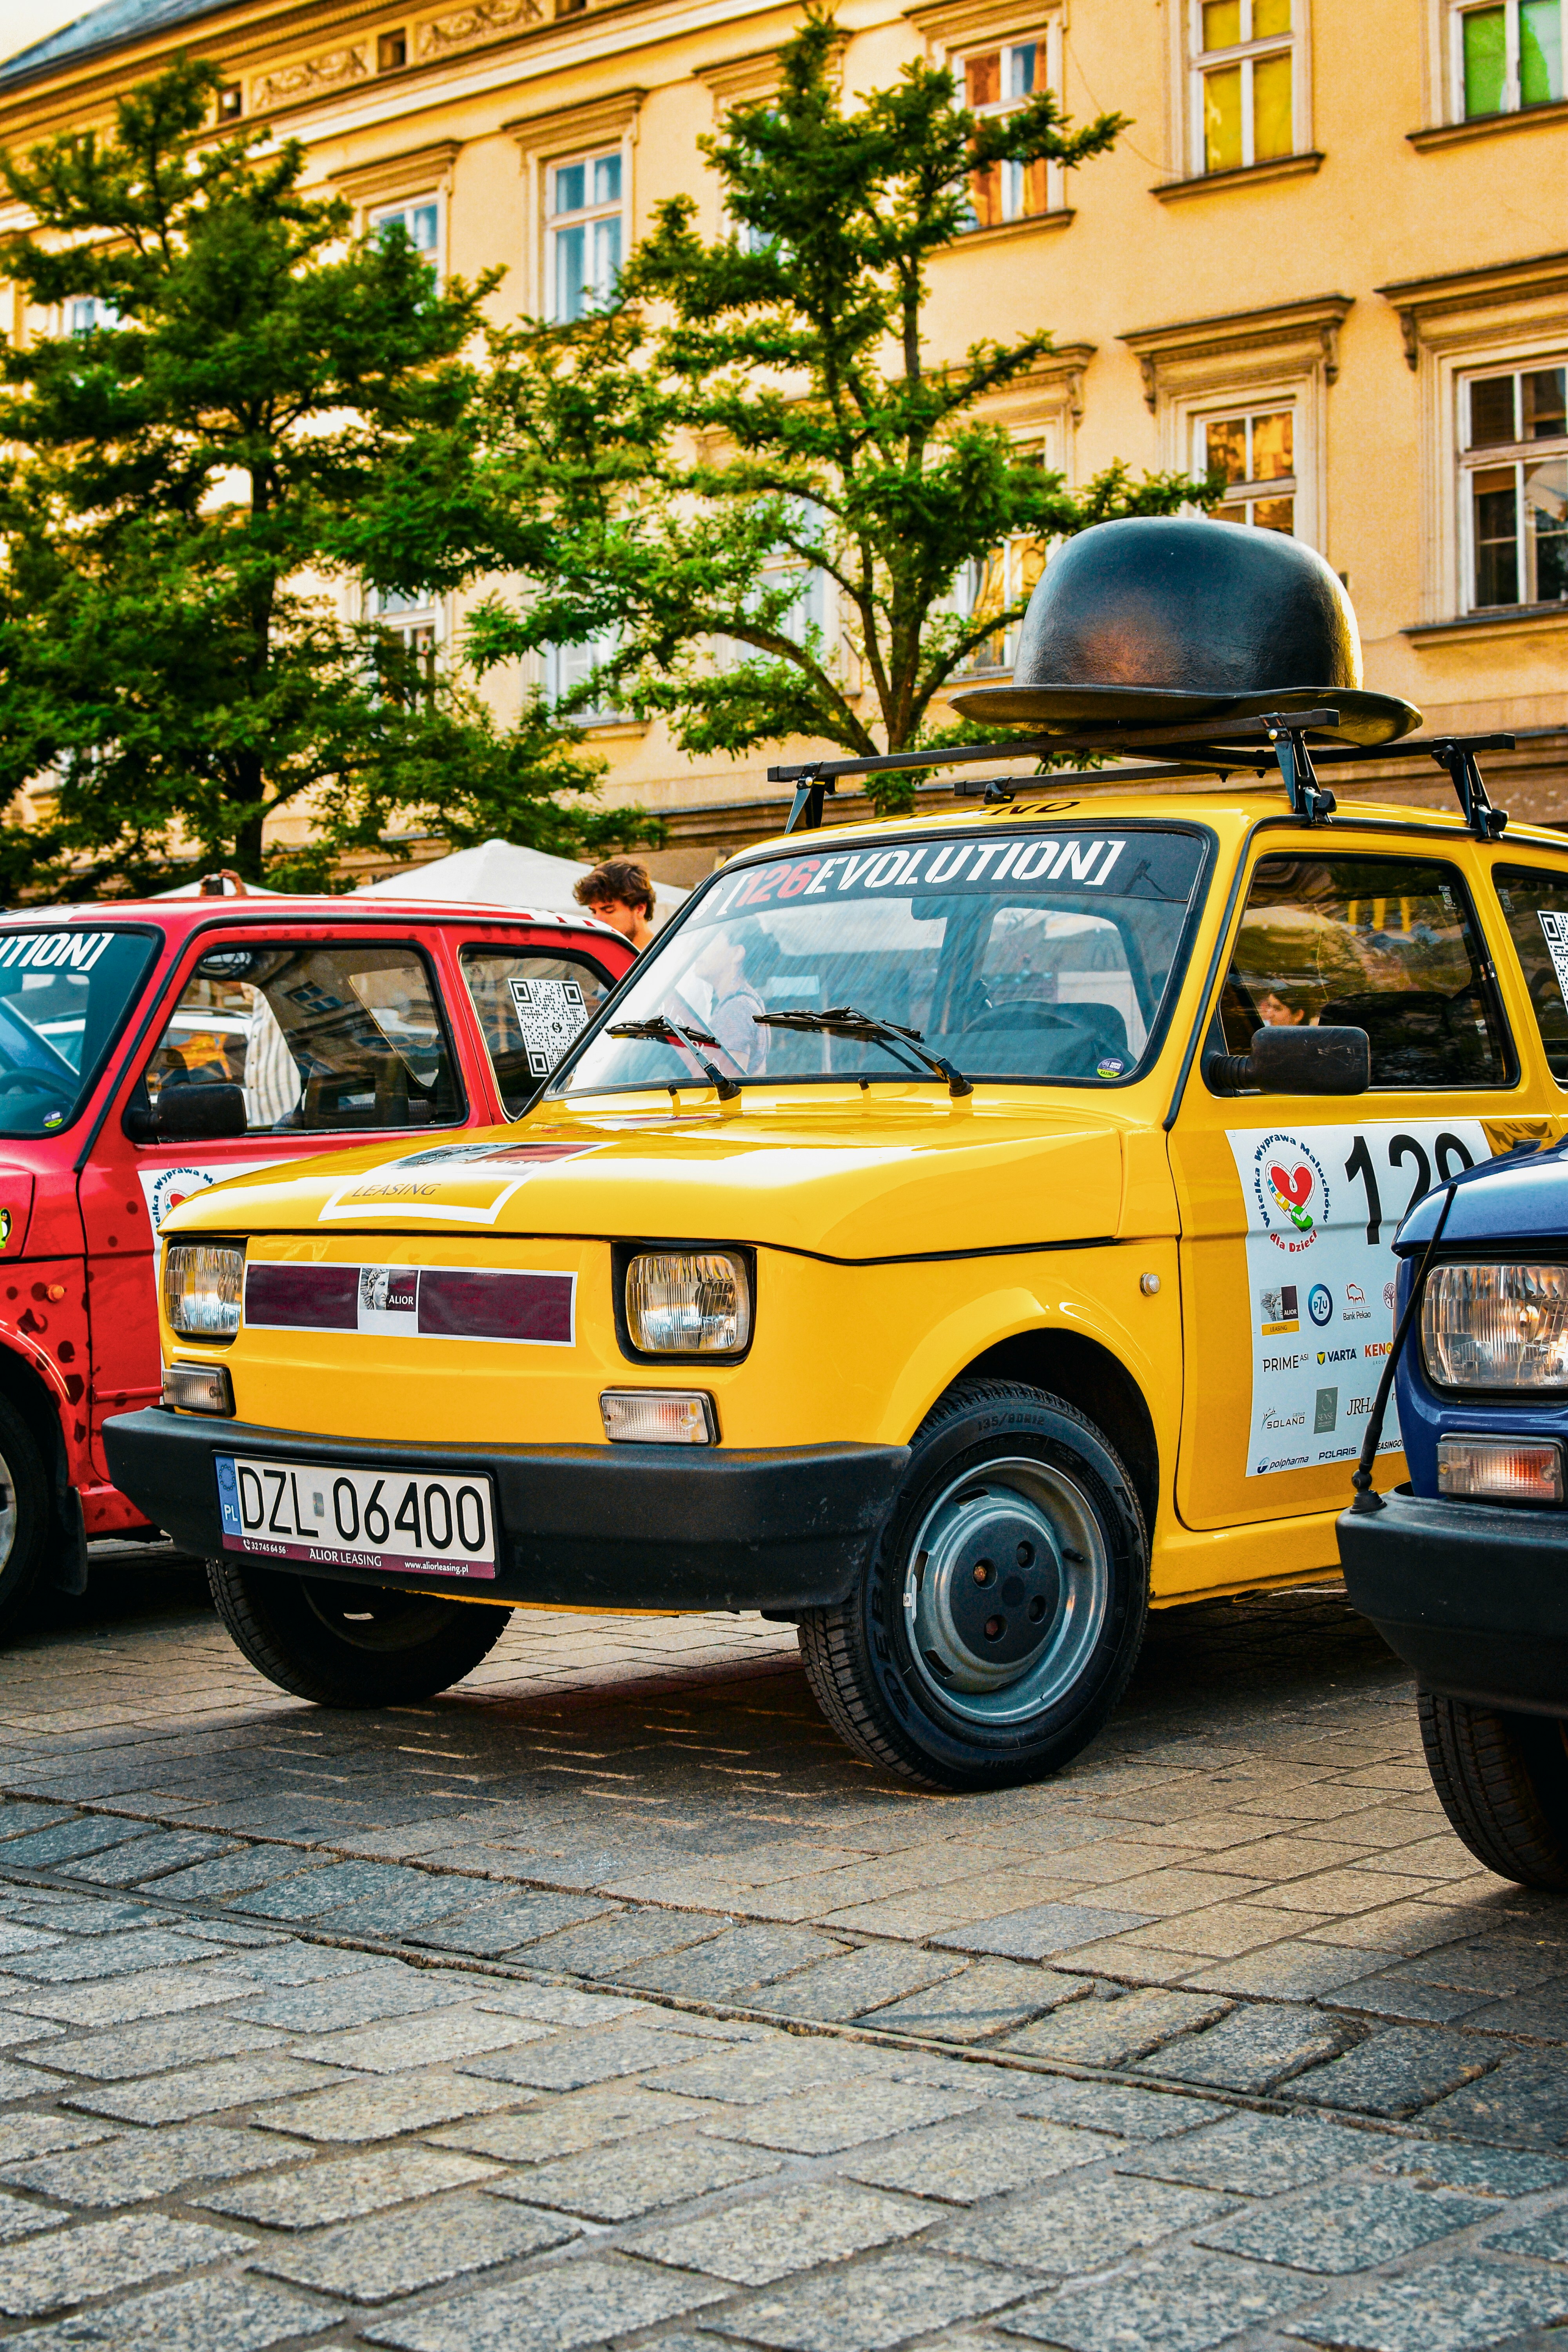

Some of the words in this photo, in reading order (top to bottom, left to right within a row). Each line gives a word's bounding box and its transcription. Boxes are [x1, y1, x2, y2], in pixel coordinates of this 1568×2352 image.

[1254, 1134, 1296, 1161] Wyprawa
[154, 1167, 200, 1191] Wyprawa
[1300, 1142, 1332, 1223] Maluchów
[352, 1183, 441, 1198] LEASING
[1254, 1167, 1270, 1228] Wielka
[1270, 1233, 1285, 1250] dla
[1289, 1230, 1318, 1252] Dzieci
[388, 1295, 414, 1305] ALIOR
[1313, 1296, 1328, 1314] PZU
[1343, 1312, 1356, 1321] Bank
[1356, 1311, 1371, 1319] Pekao
[1262, 1355, 1299, 1372] PRIME
[1327, 1348, 1357, 1362] VARTA
[1267, 1416, 1305, 1429] SOLANO
[1318, 1446, 1357, 1460] POLARIS
[1269, 1456, 1309, 1470] polpharma
[223, 1504, 238, 1522] PL
[309, 1548, 339, 1563] ALIOR
[340, 1552, 382, 1567] LEASING
[404, 1561, 469, 1575] www.aliorleasing.pl
